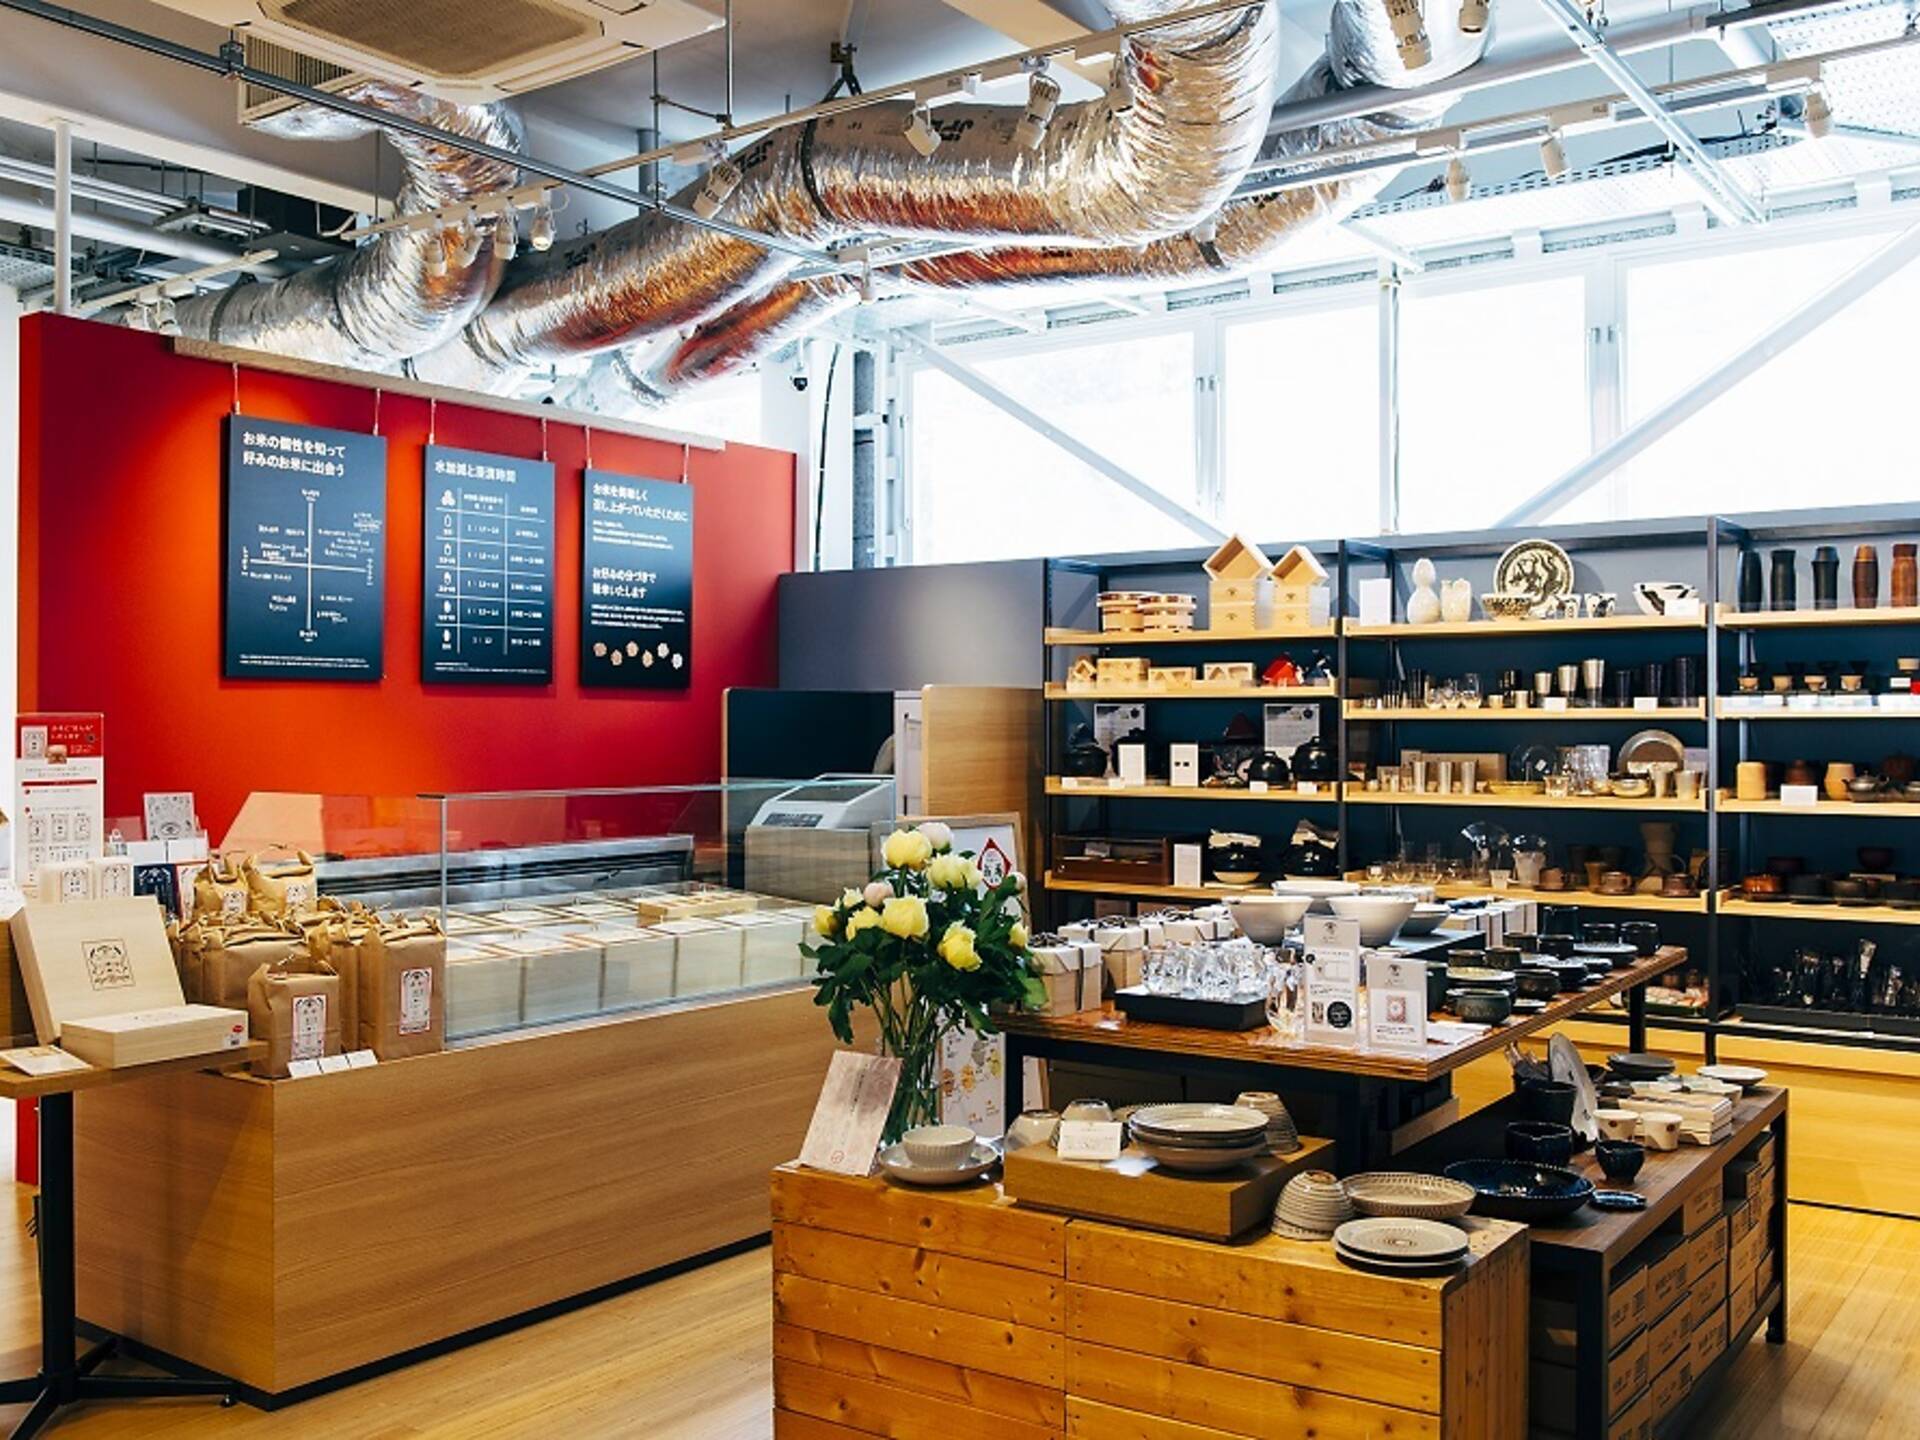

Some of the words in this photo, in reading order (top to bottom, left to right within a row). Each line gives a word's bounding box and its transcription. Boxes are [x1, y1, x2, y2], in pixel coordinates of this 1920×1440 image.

[243, 432, 345, 458] お米の個性を知って
[243, 450, 345, 477] 好みのお米に出会う
